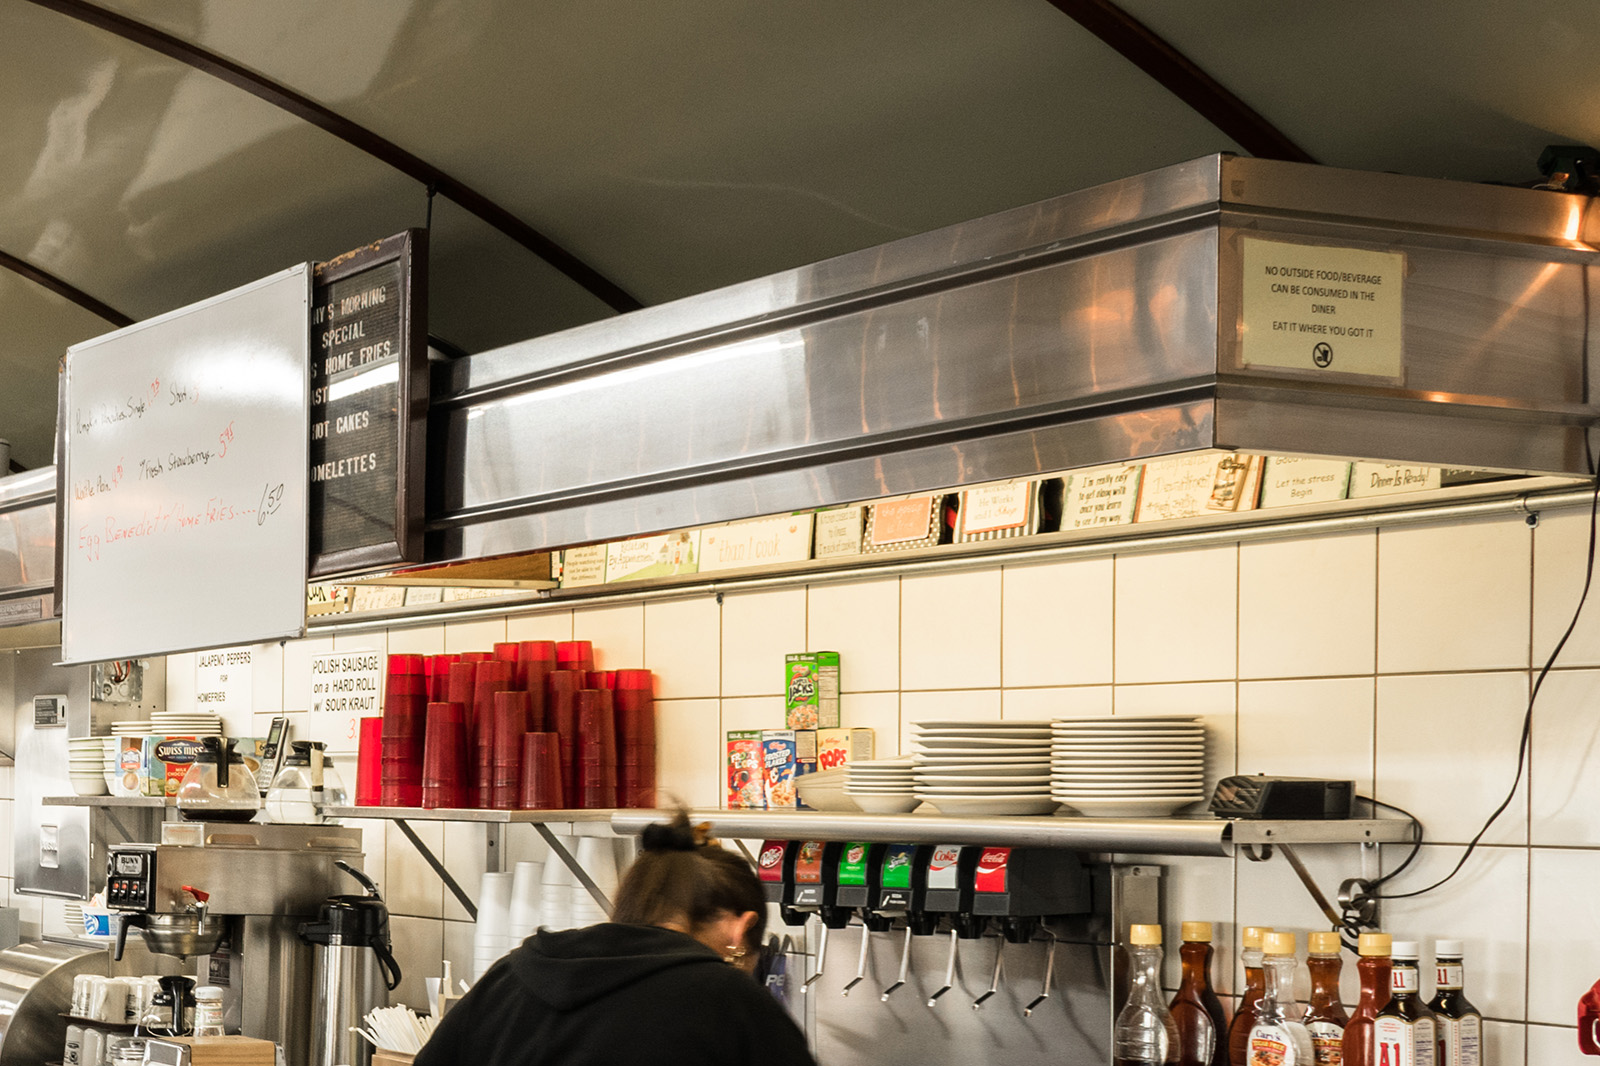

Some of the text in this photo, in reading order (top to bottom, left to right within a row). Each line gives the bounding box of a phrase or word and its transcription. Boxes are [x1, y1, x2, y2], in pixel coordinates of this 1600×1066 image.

[1265, 266, 1382, 285] NO OUTSIDE FOOD/BEVERAGE
[341, 286, 385, 315] MORNING
[1271, 284, 1376, 301] CAN BE CONSUMED IN THE
[1311, 304, 1336, 315] DINER
[322, 321, 365, 349] SPECIAL
[1273, 321, 1374, 338] EAT IT WHERE YOU GOT IT
[325, 351, 354, 375] HOME
[360, 341, 390, 365] FRIES
[337, 411, 369, 434] CAKES
[1096, 474, 1113, 488] really
[1276, 474, 1335, 489] Let the stress
[1291, 487, 1313, 499] Begin
[719, 539, 745, 563] than
[756, 533, 781, 559] cook
[199, 651, 252, 668] JALAPENO PEPPERS
[313, 655, 379, 674] POLISH SAUSAGE
[313, 676, 377, 694] on a HARD ROLL
[788, 682, 814, 706] JACKS
[325, 697, 347, 712] SOUR
[350, 695, 375, 711] KRAUT
[819, 748, 847, 770] POPS
[121, 856, 139, 864] BUNN
[934, 850, 957, 862] Coke
